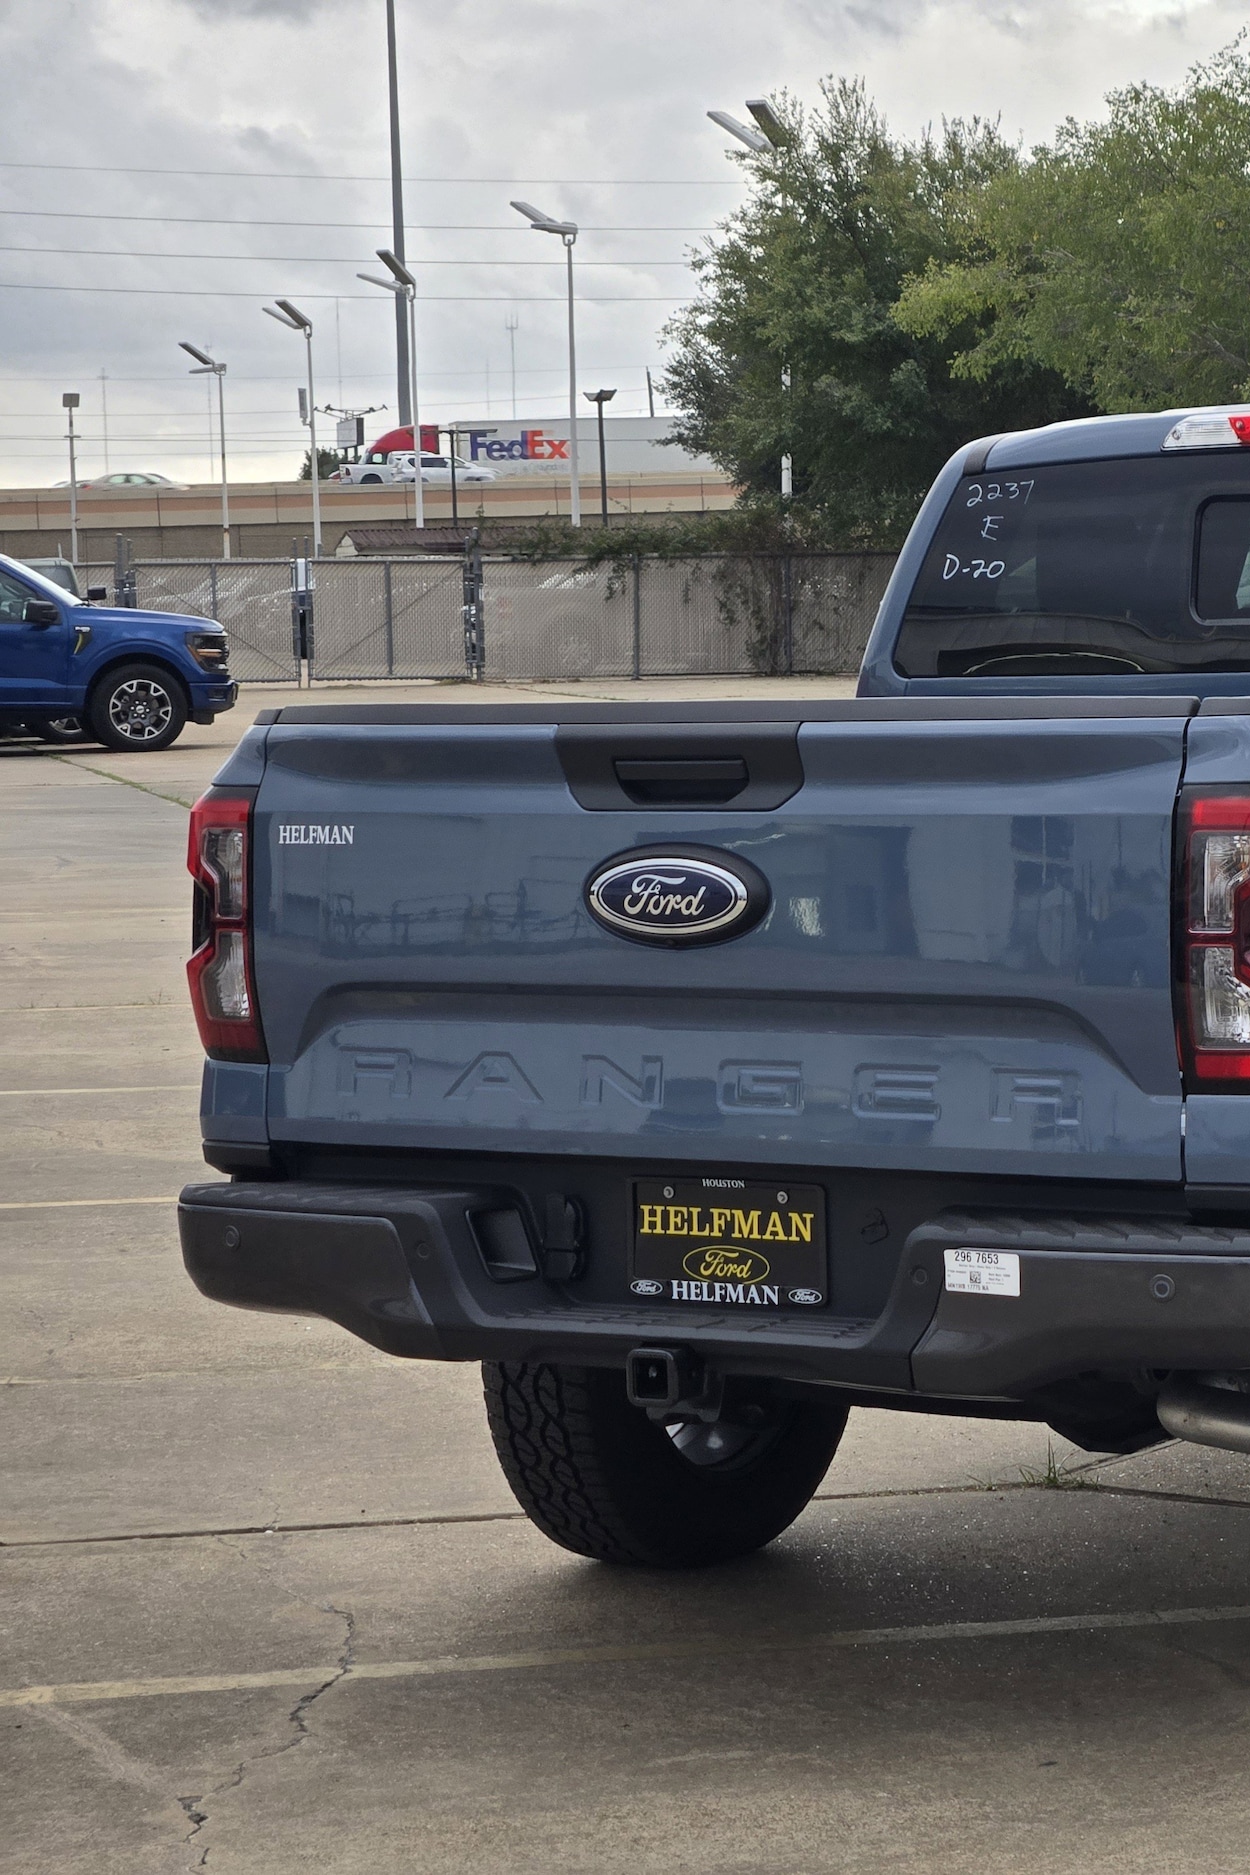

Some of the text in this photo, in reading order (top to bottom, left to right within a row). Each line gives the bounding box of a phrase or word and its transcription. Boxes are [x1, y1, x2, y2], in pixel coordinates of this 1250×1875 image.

[469, 430, 569, 461] FedEx
[966, 480, 1034, 507] 2237
[981, 515, 1004, 541] E
[278, 824, 355, 845] HELFMAN
[623, 874, 707, 916] Ford
[337, 1046, 1083, 1125] RANGER
[702, 1178, 745, 1189] HOUSTON
[639, 1204, 815, 1242] HELFMAN
[700, 1250, 753, 1279] Ford
[954, 1250, 999, 1265] 296 7653
[635, 1281, 658, 1293] Ford
[671, 1279, 780, 1306] HELFMAN
[793, 1290, 817, 1302] Ford
